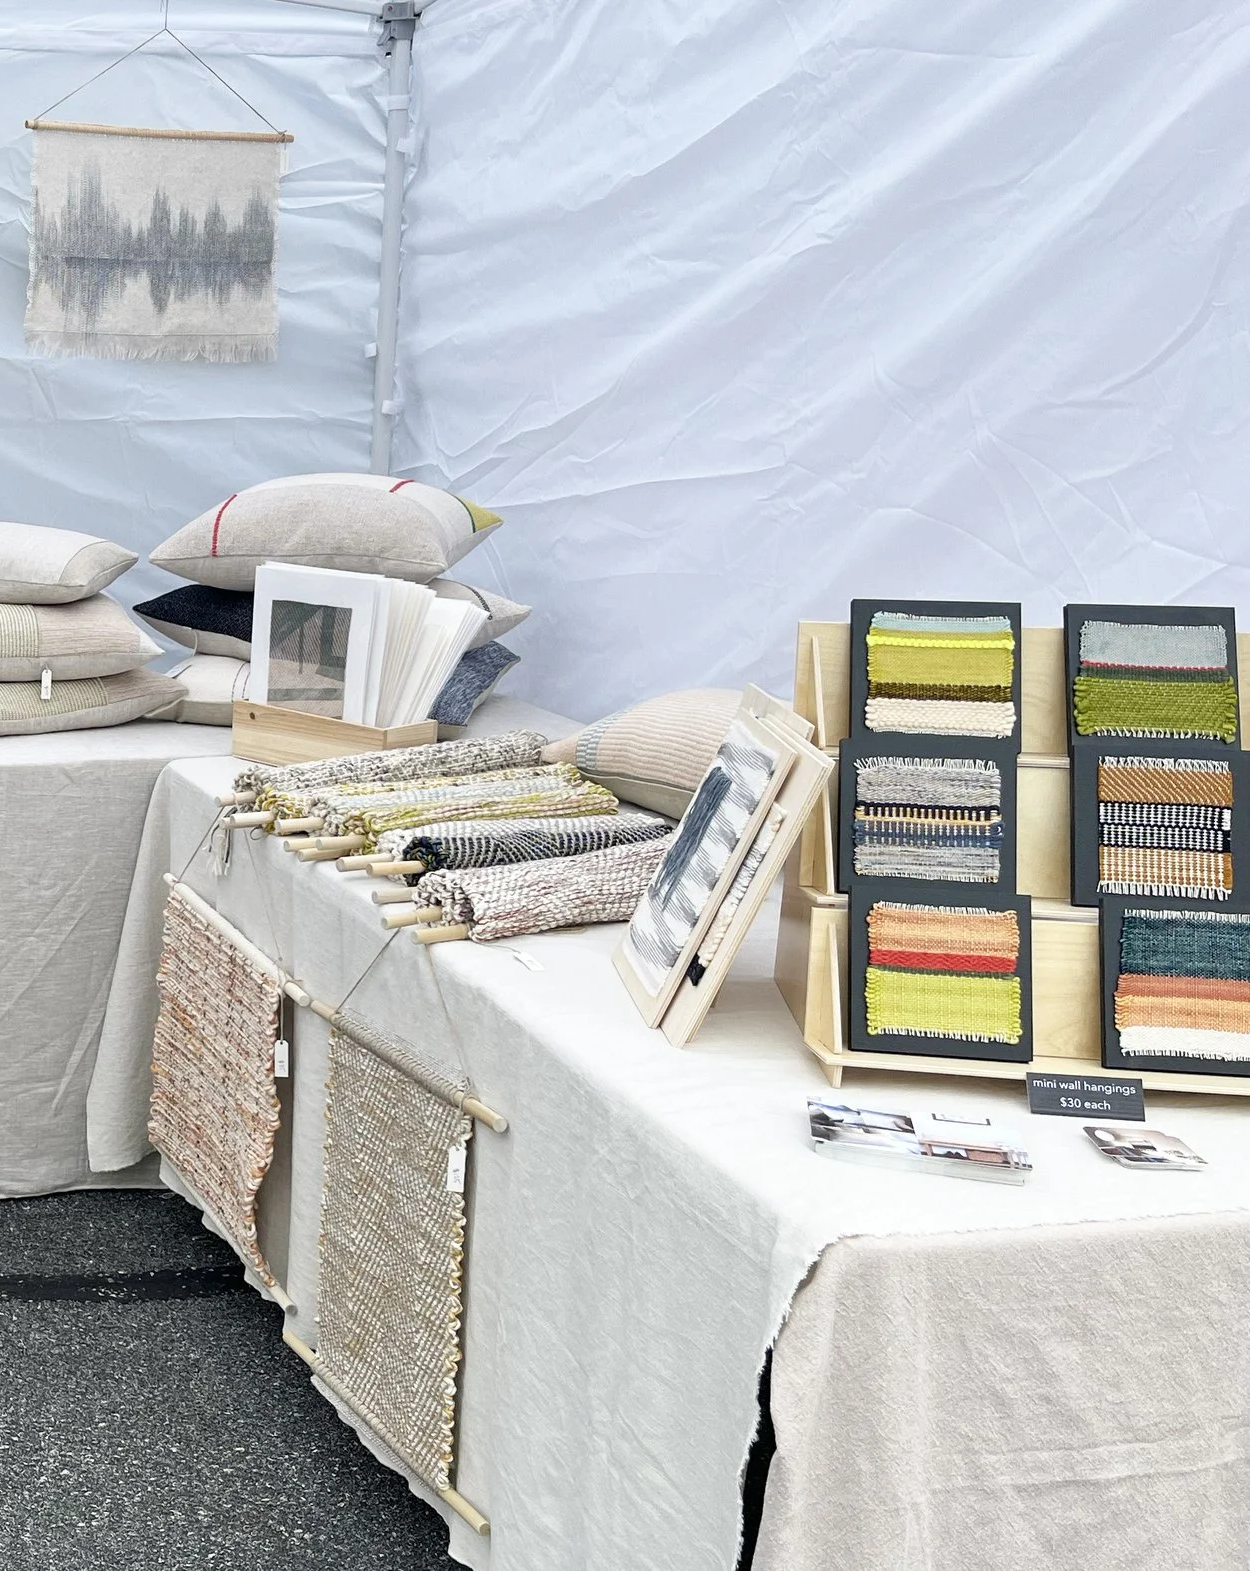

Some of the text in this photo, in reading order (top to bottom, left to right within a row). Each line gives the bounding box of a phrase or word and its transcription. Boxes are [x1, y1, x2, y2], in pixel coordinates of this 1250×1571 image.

[1033, 1078, 1136, 1096] mini wall hangings
[1060, 1096, 1111, 1111] $30 each
